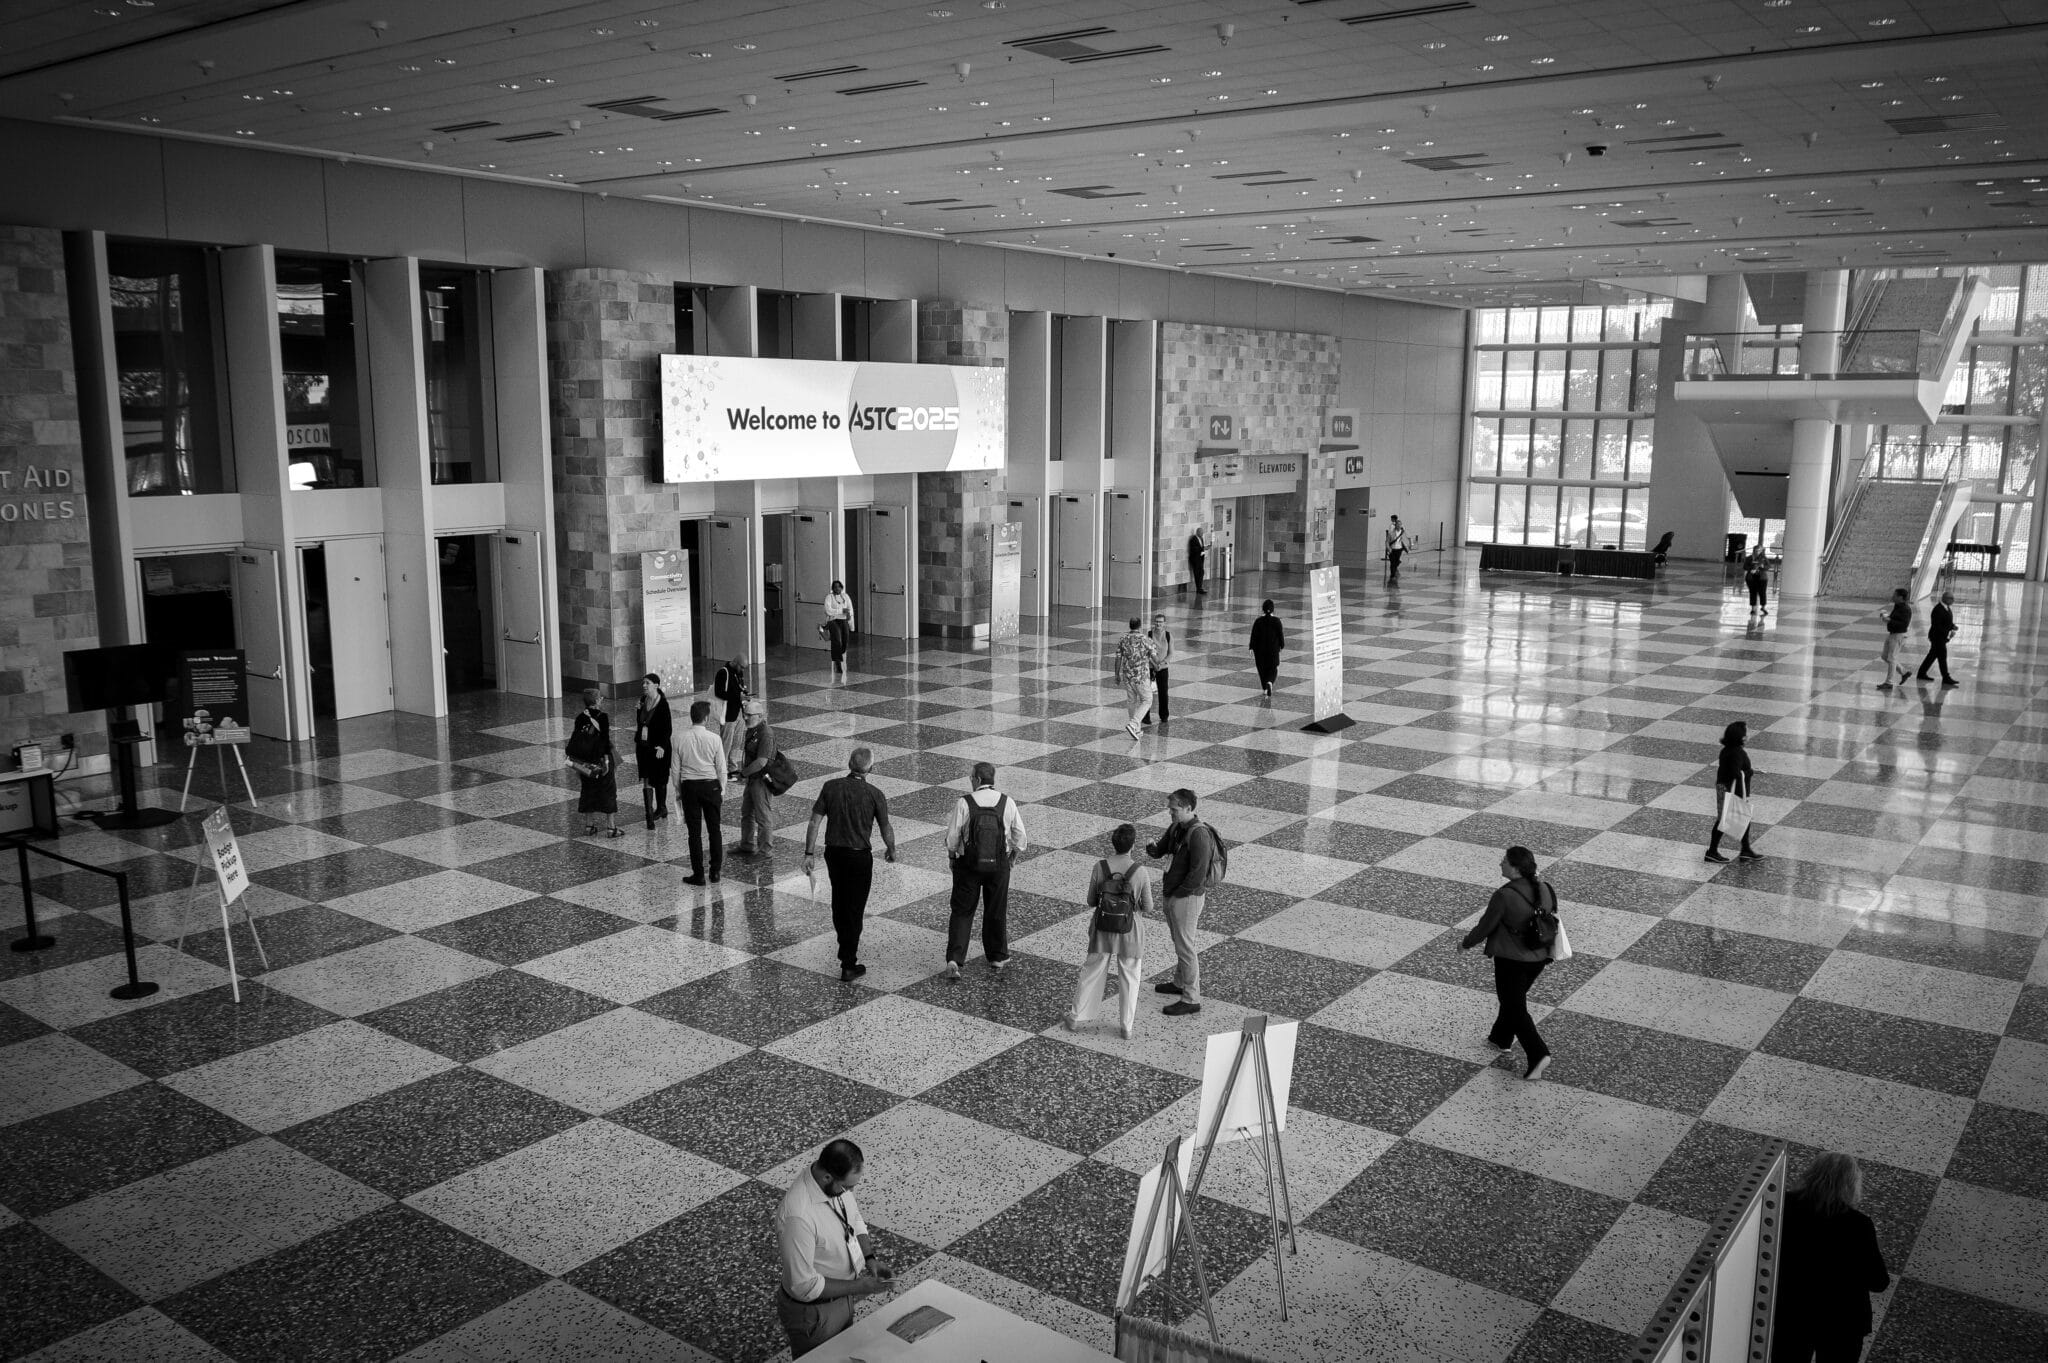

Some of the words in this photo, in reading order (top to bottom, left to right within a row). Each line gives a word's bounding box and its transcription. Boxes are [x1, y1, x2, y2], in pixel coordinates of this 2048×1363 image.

[727, 406, 817, 430] Welcome
[823, 410, 841, 429] to
[0, 501, 75, 521] ONES
[216, 842, 233, 859] Badge
[221, 855, 237, 872] Pickup
[226, 869, 239, 884] Here
